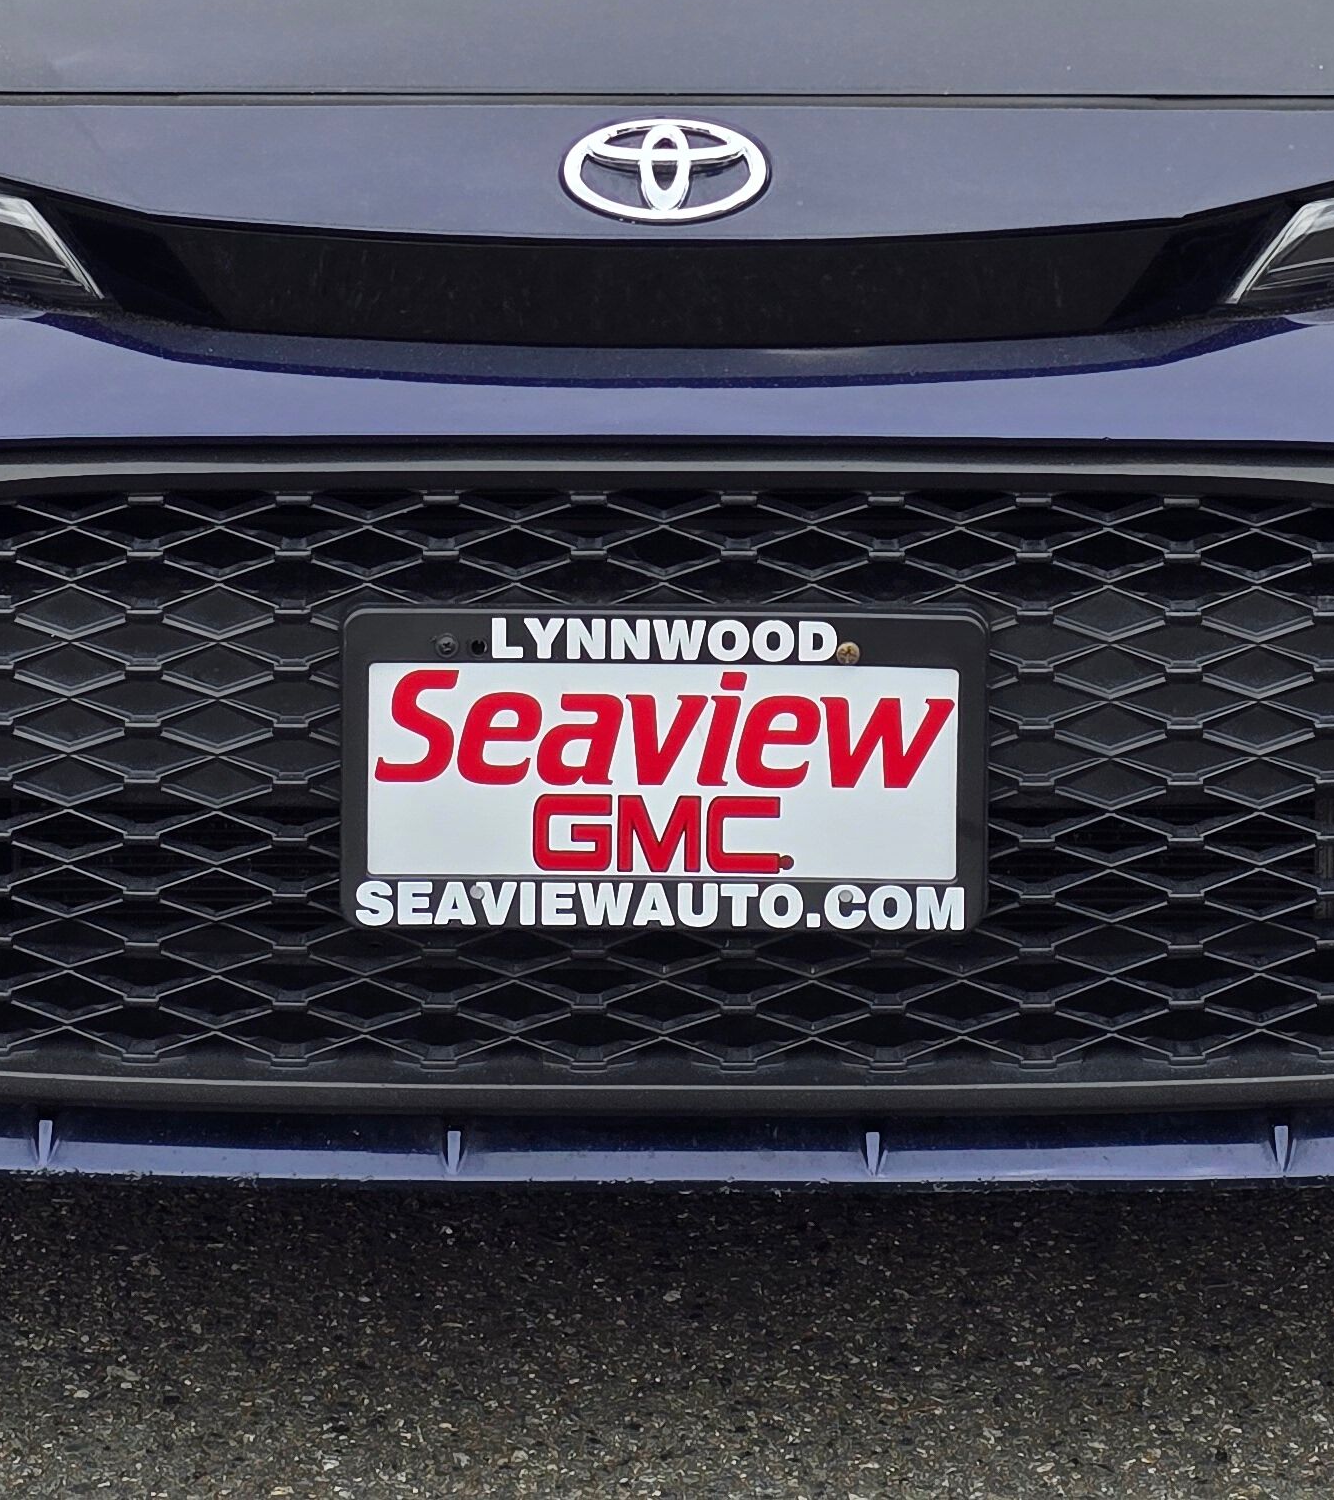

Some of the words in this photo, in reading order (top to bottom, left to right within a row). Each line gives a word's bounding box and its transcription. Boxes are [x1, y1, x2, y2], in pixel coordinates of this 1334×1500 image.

[491, 617, 839, 663] LYNNWOOD
[374, 669, 956, 790] Seaview
[532, 793, 793, 874] GMC
[355, 880, 966, 932] SEAVIEWAUTO.COM
